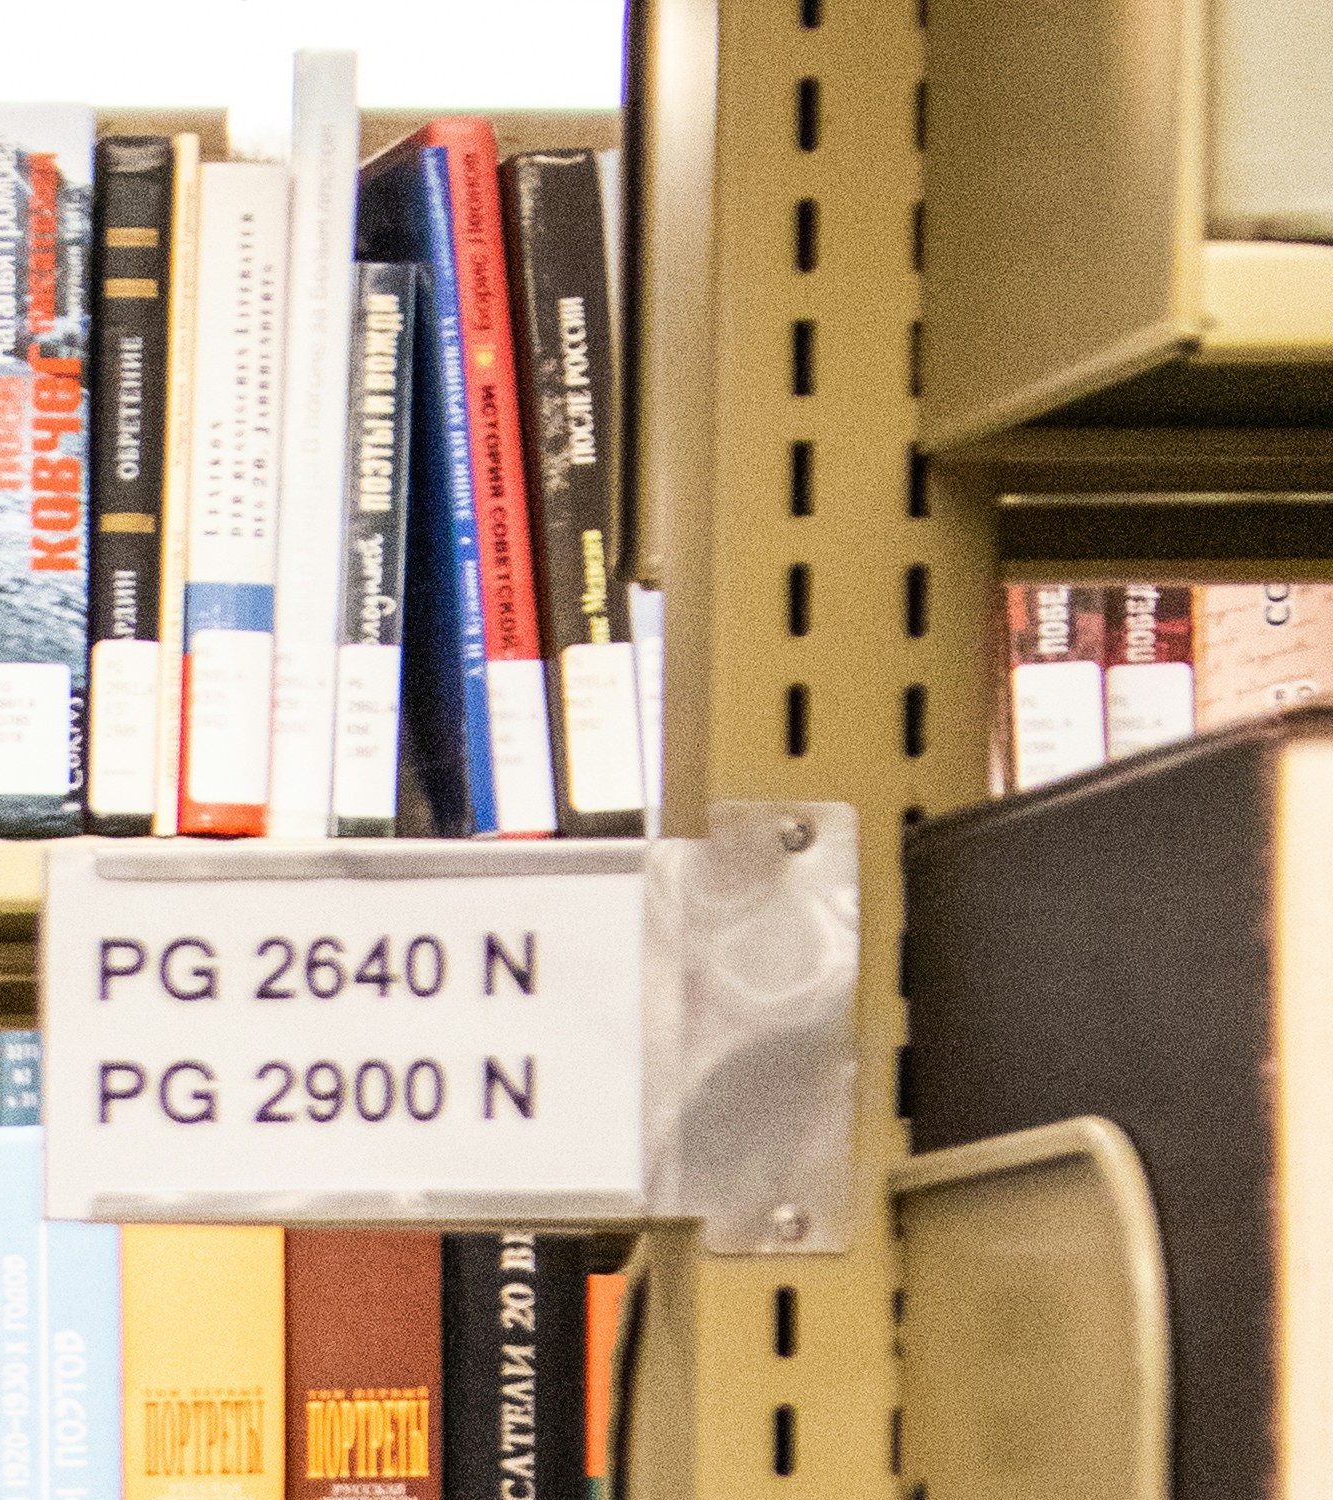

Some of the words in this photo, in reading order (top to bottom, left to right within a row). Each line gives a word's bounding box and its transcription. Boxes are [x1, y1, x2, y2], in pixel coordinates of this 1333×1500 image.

[363, 293, 403, 392] ВОЖДИ
[558, 296, 591, 386] РОССИИ
[117, 336, 144, 482] ОБРЕТЕНИЕ
[363, 394, 395, 415] И
[481, 384, 506, 500] ИСТОРИЯ
[566, 388, 598, 465] ПОСЛЕ
[357, 419, 394, 512] ПОЭТЫ
[99, 937, 217, 1002] PG
[254, 935, 445, 1001] 2640
[483, 934, 535, 996] N
[99, 1060, 216, 1126] PG
[254, 1058, 445, 1124] 2900
[482, 1057, 535, 1119] N
[500, 1283, 535, 1331] 20
[50, 1330, 88, 1469] ПОЭТОВ
[144, 1400, 265, 1476] ПОРТРЕТЫ
[306, 1400, 430, 1479] ПОРТРЕТЫ
